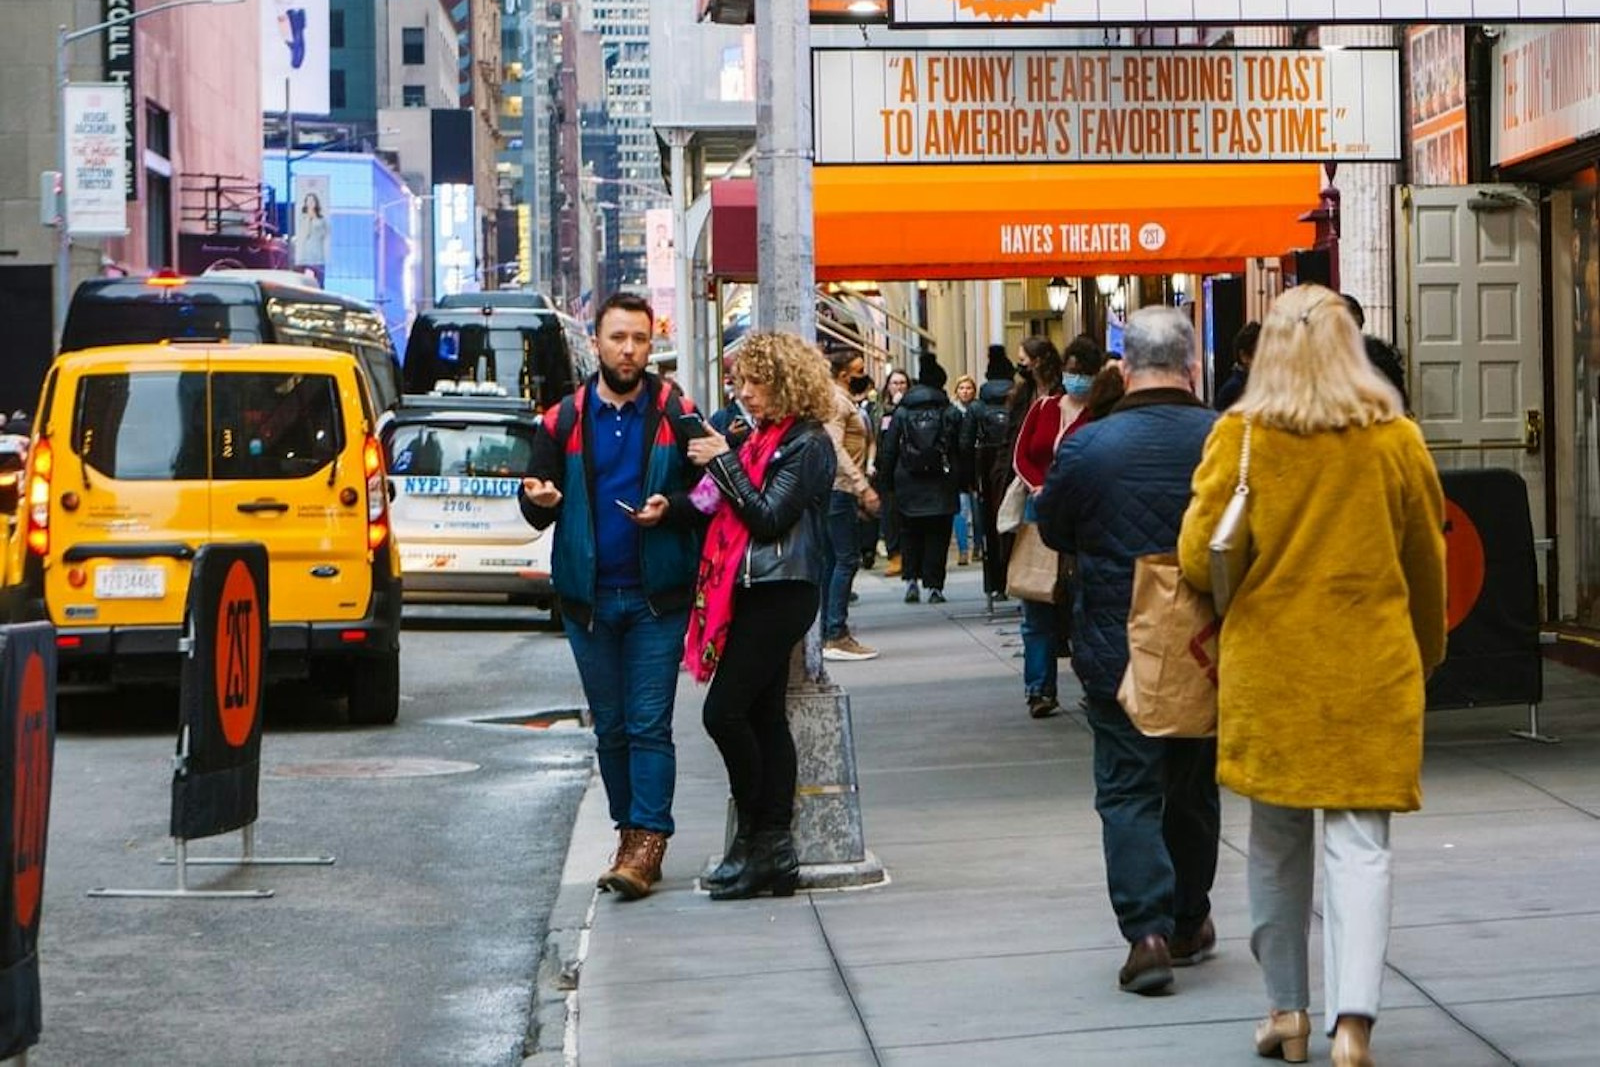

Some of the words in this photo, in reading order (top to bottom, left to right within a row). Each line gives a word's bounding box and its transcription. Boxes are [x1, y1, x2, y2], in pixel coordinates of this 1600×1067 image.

[926, 56, 1019, 109] FUNNY,
[1026, 54, 1234, 104] HEART-RENDING
[1242, 54, 1326, 102] TOAST
[880, 108, 915, 156] TO
[923, 107, 1071, 157] AMERICA'S
[1081, 107, 1204, 156] FAVORITE
[1001, 224, 1054, 255] HAYES
[1060, 222, 1132, 254] THEATER
[404, 476, 450, 495] NYPD
[460, 477, 520, 498] POLICE
[224, 600, 252, 710] 2ST
